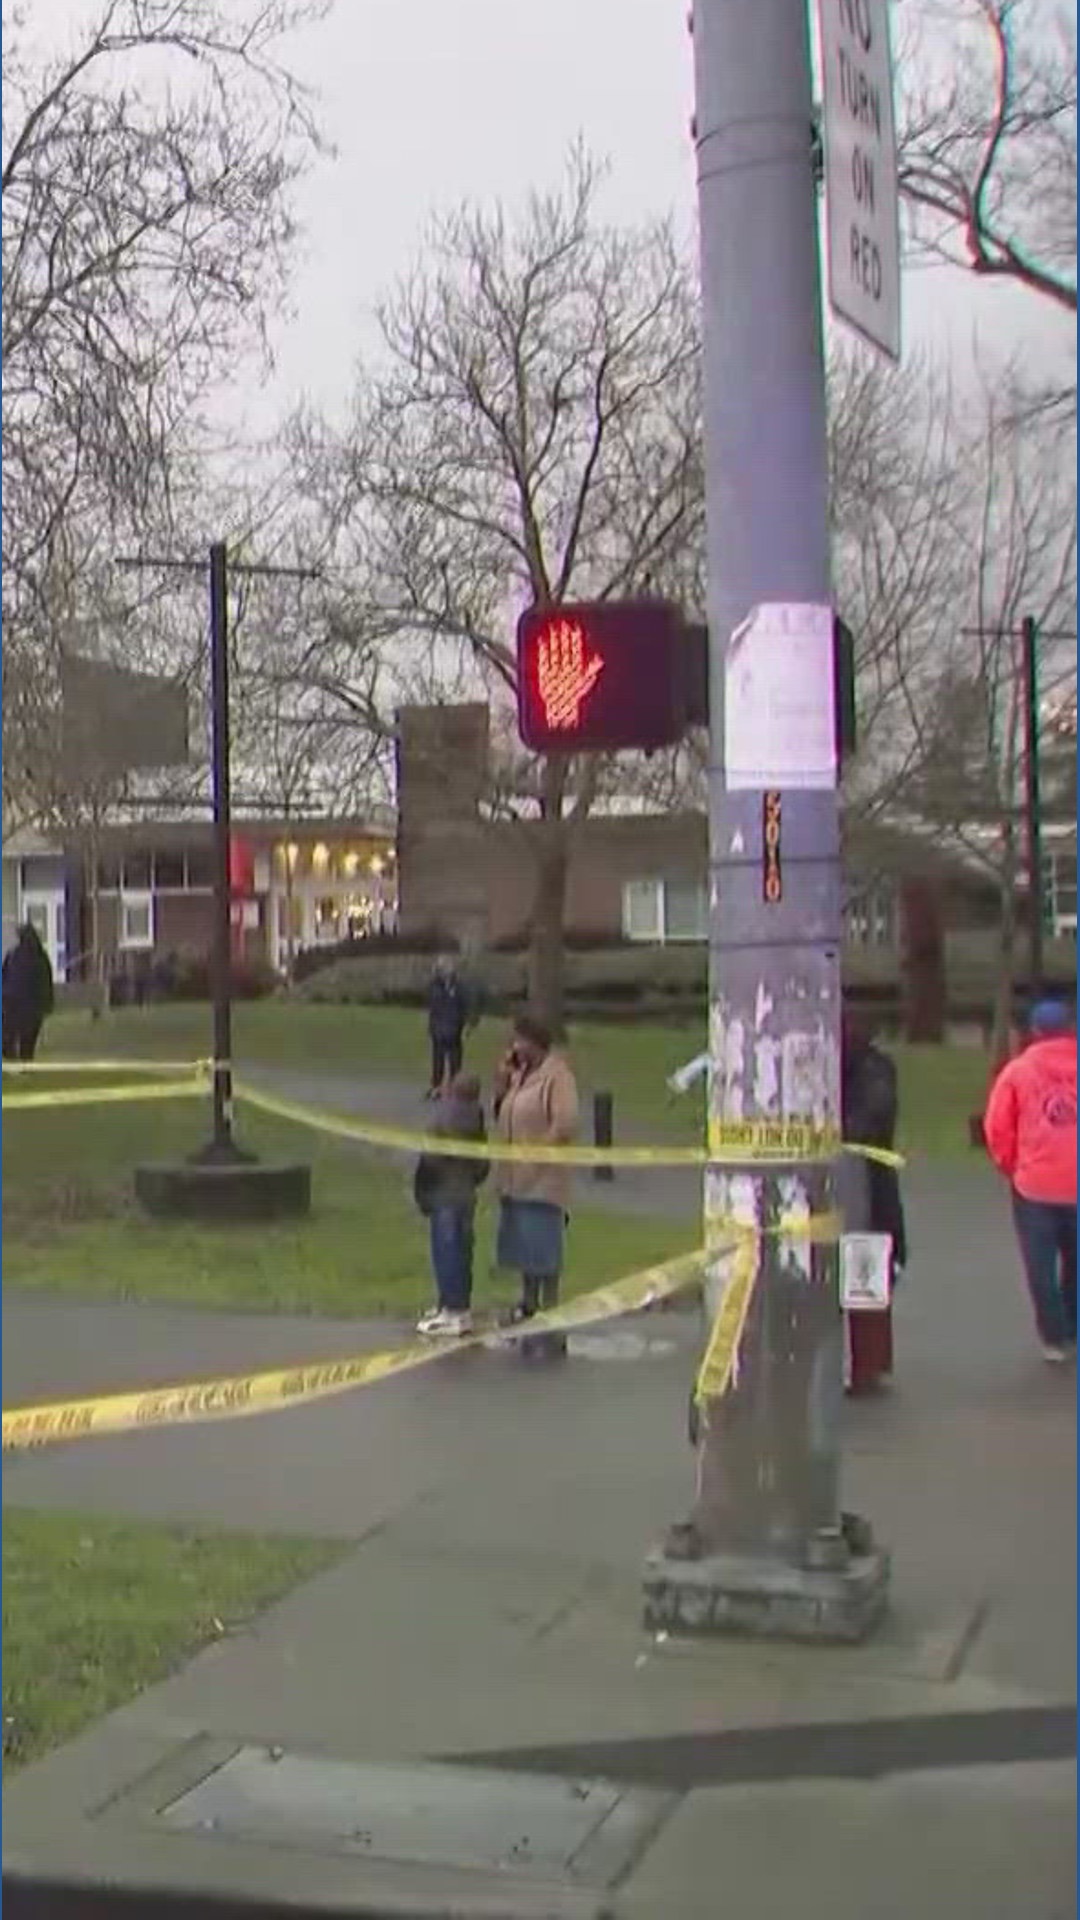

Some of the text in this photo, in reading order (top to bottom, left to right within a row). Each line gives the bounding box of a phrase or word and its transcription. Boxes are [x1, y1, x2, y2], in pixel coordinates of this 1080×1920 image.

[839, 47, 881, 138] TURN
[852, 145, 876, 214] ON
[850, 223, 882, 301] RED
